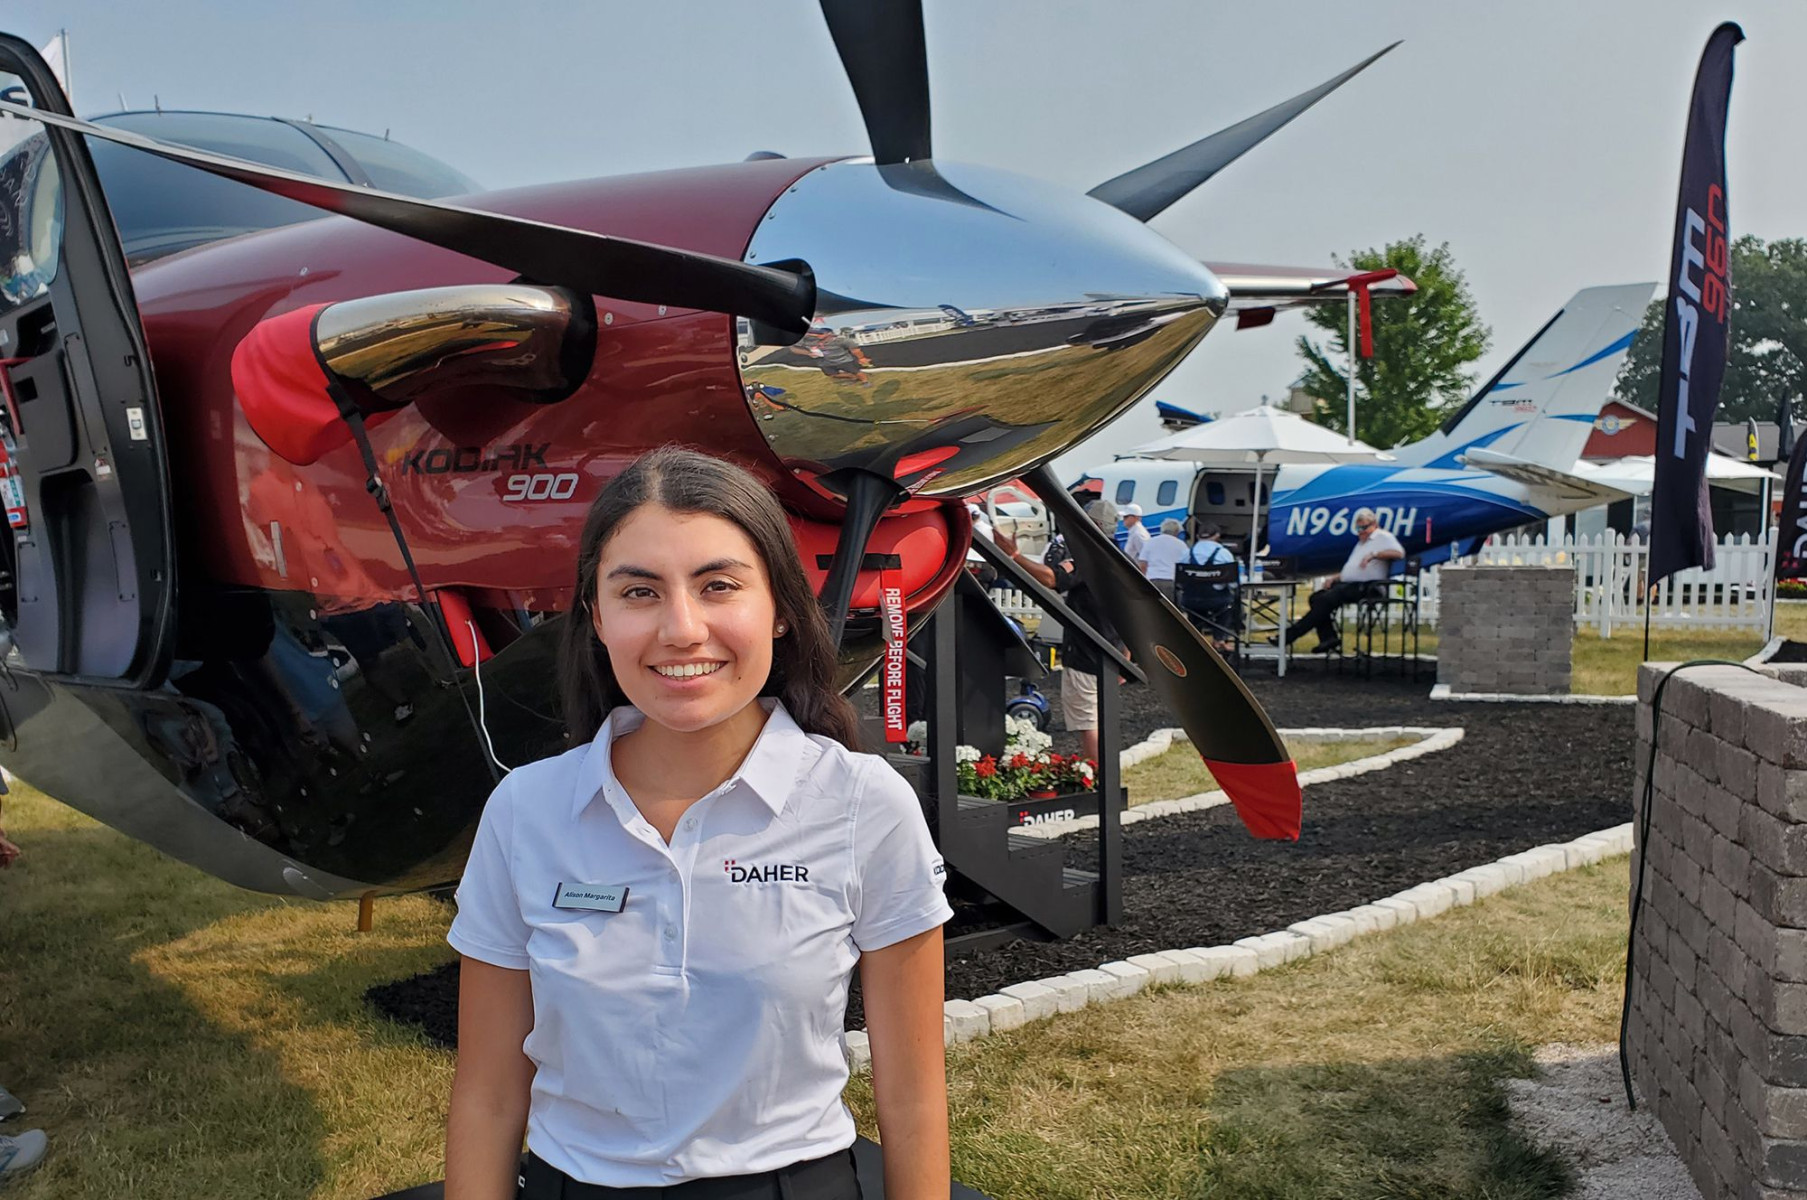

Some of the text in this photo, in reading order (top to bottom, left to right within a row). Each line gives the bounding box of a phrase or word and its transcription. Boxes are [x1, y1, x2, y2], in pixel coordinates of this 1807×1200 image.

[1674, 207, 1705, 460] TBM
[503, 473, 579, 501] 900
[885, 588, 904, 730] REMOVE BEFORE FLIGHT
[731, 864, 809, 882] DAHER
[584, 892, 616, 901] Margarita
